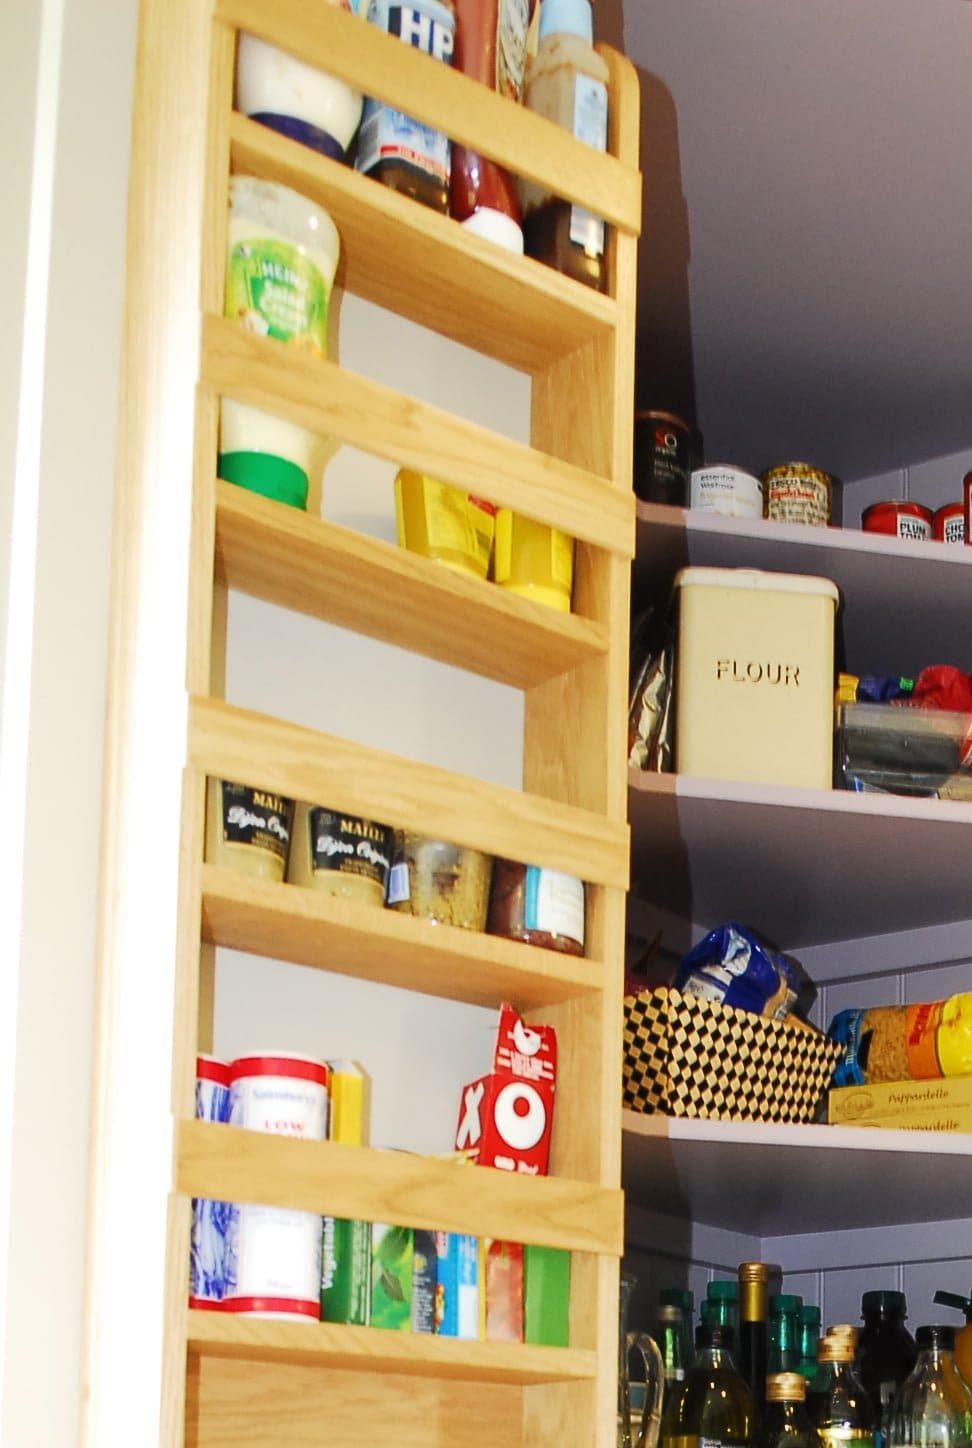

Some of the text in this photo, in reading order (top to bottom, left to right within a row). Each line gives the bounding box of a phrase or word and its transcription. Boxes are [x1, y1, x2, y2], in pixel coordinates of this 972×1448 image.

[400, 8, 455, 62] HP
[899, 522, 926, 535] PLUM
[716, 659, 801, 686] FLOUR
[253, 792, 284, 814] MAIL
[340, 819, 385, 843] MAILL
[264, 1119, 306, 1132] LOW
[321, 1215, 337, 1290] Vegetabl
